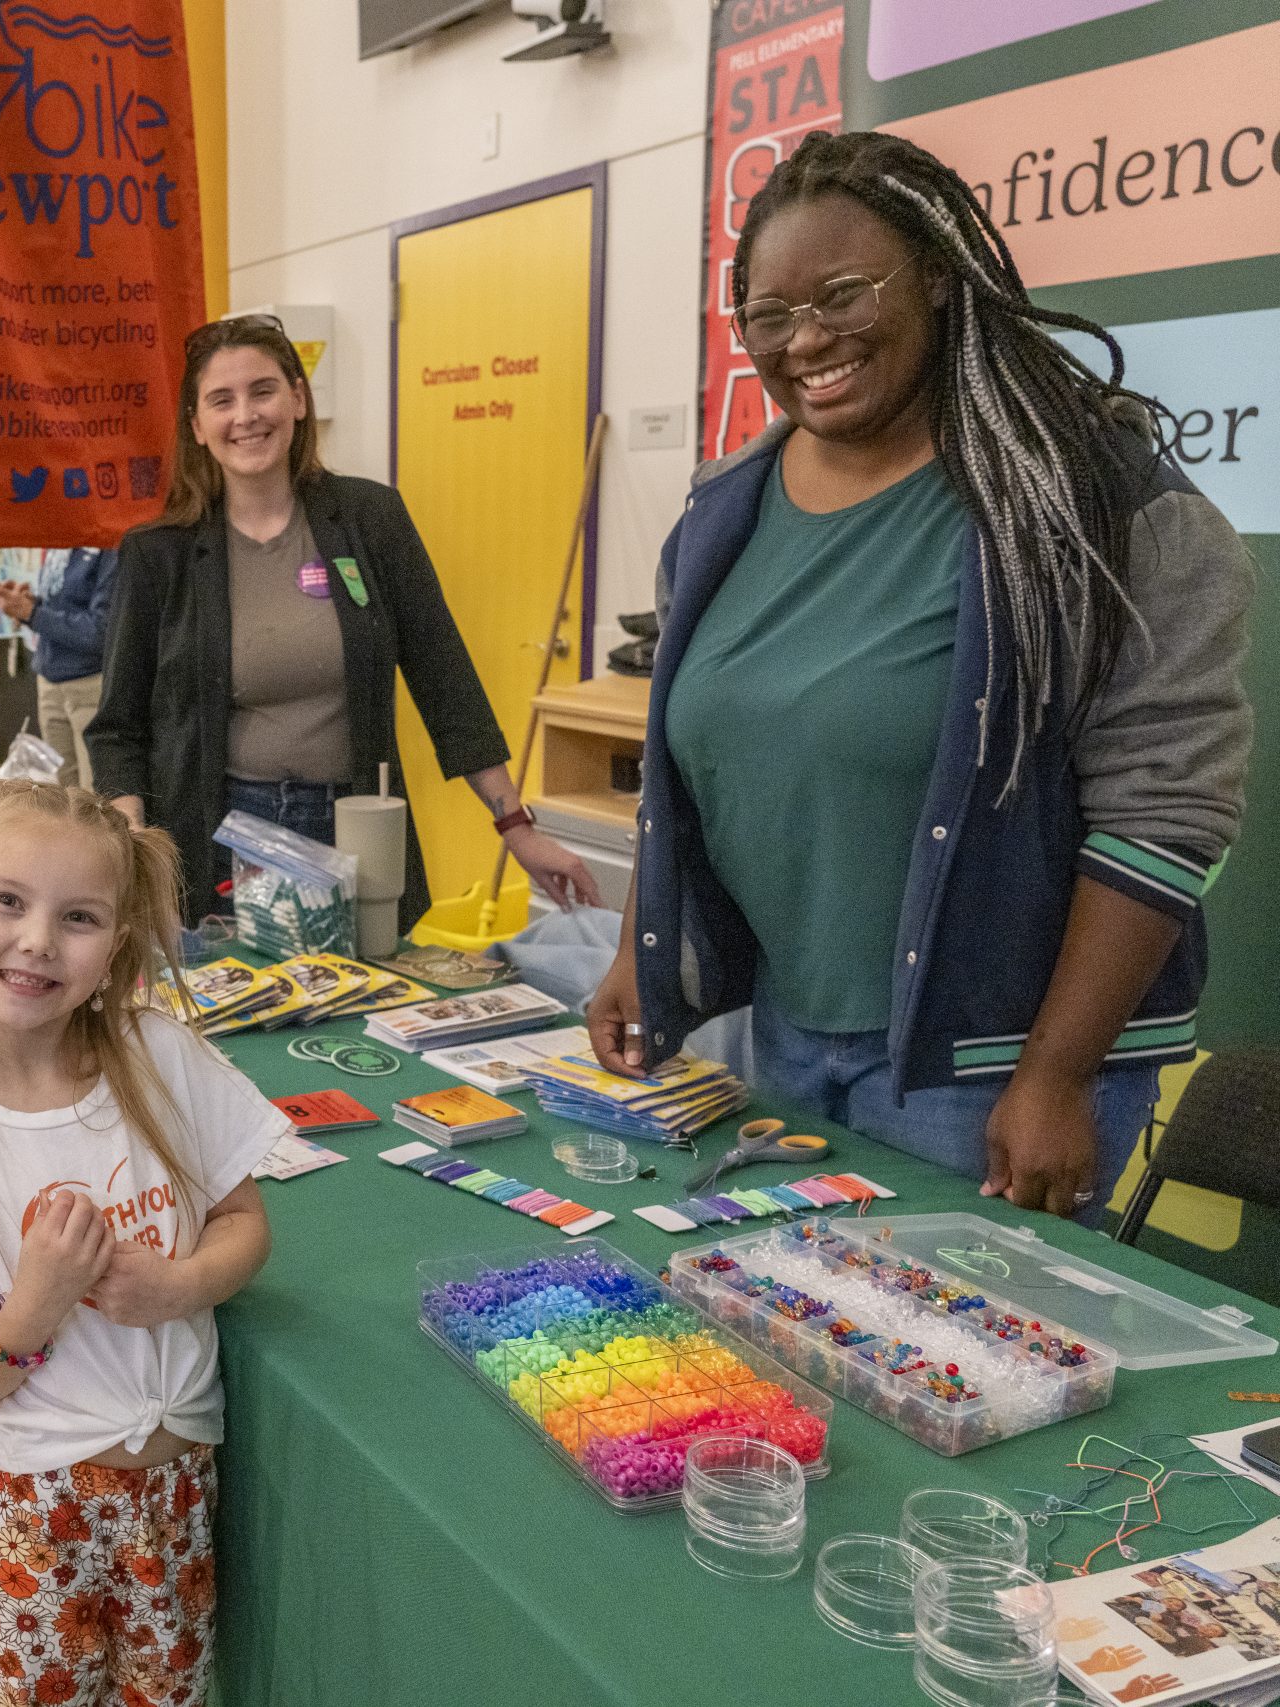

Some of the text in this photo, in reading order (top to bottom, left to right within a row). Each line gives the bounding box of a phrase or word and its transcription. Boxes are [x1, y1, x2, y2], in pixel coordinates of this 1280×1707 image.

[23, 48, 169, 167] bike
[728, 46, 841, 134] STA
[972, 126, 1280, 228] nfidenc
[41, 283, 111, 307] more,
[55, 318, 156, 349] bicycling
[491, 356, 539, 377] Closet
[488, 400, 513, 422] Only
[1153, 395, 1260, 465] er
